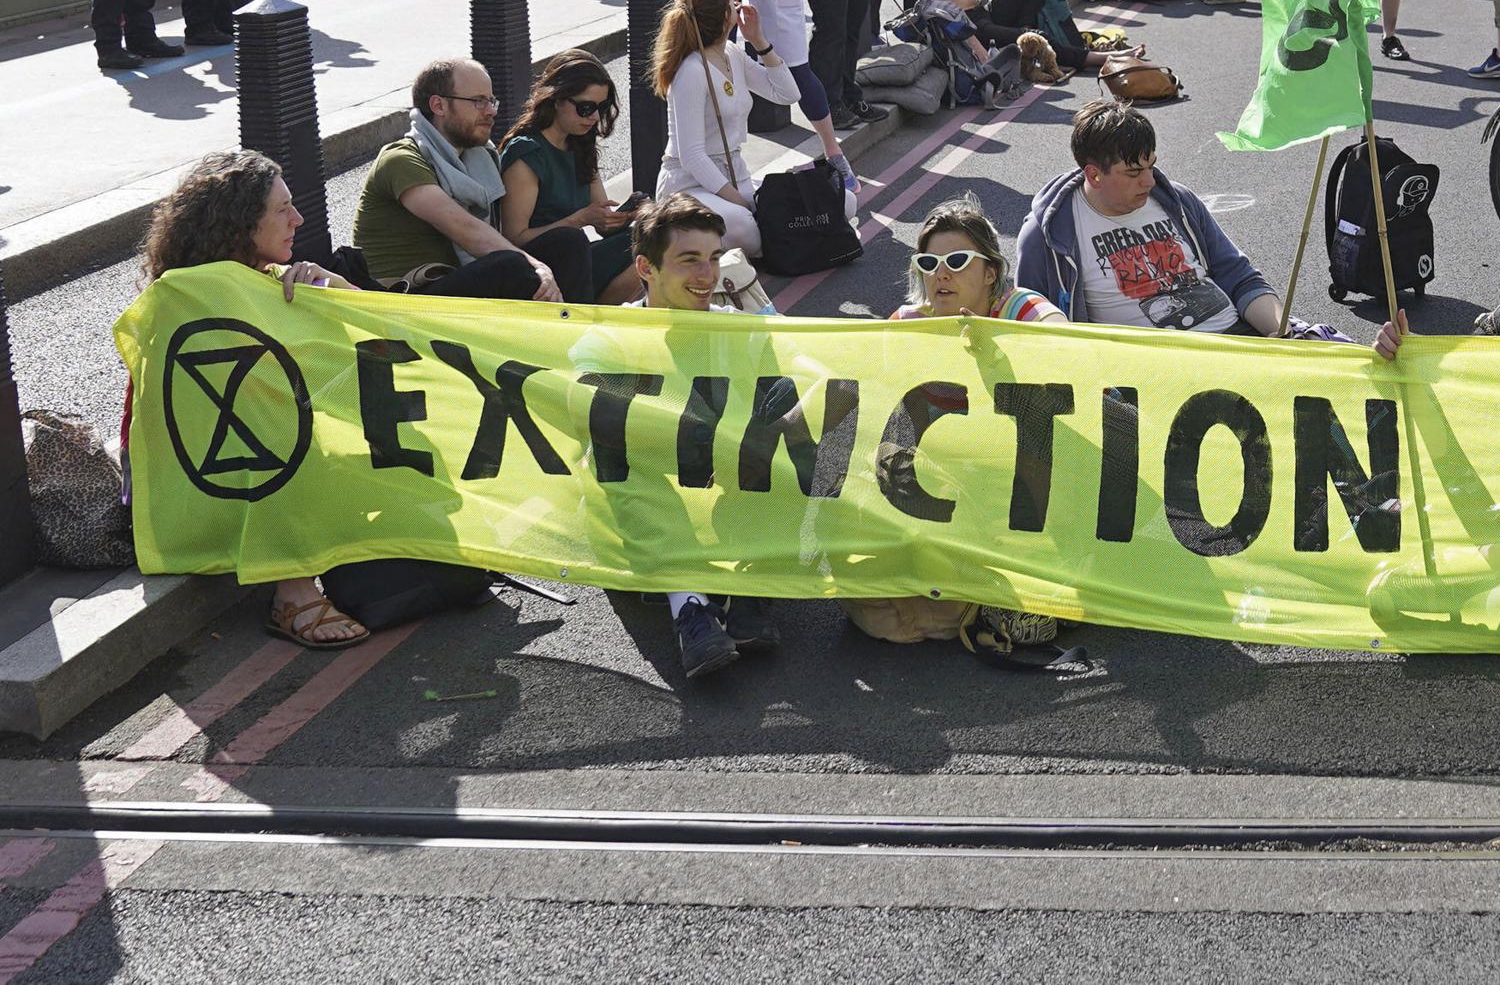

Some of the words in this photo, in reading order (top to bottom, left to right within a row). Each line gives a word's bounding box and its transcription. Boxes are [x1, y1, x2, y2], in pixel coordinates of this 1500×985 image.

[1091, 226, 1146, 259] GREEN
[1142, 219, 1175, 242] DAY
[1119, 252, 1181, 291] RADIO
[355, 338, 1402, 558] EXTINCTION
